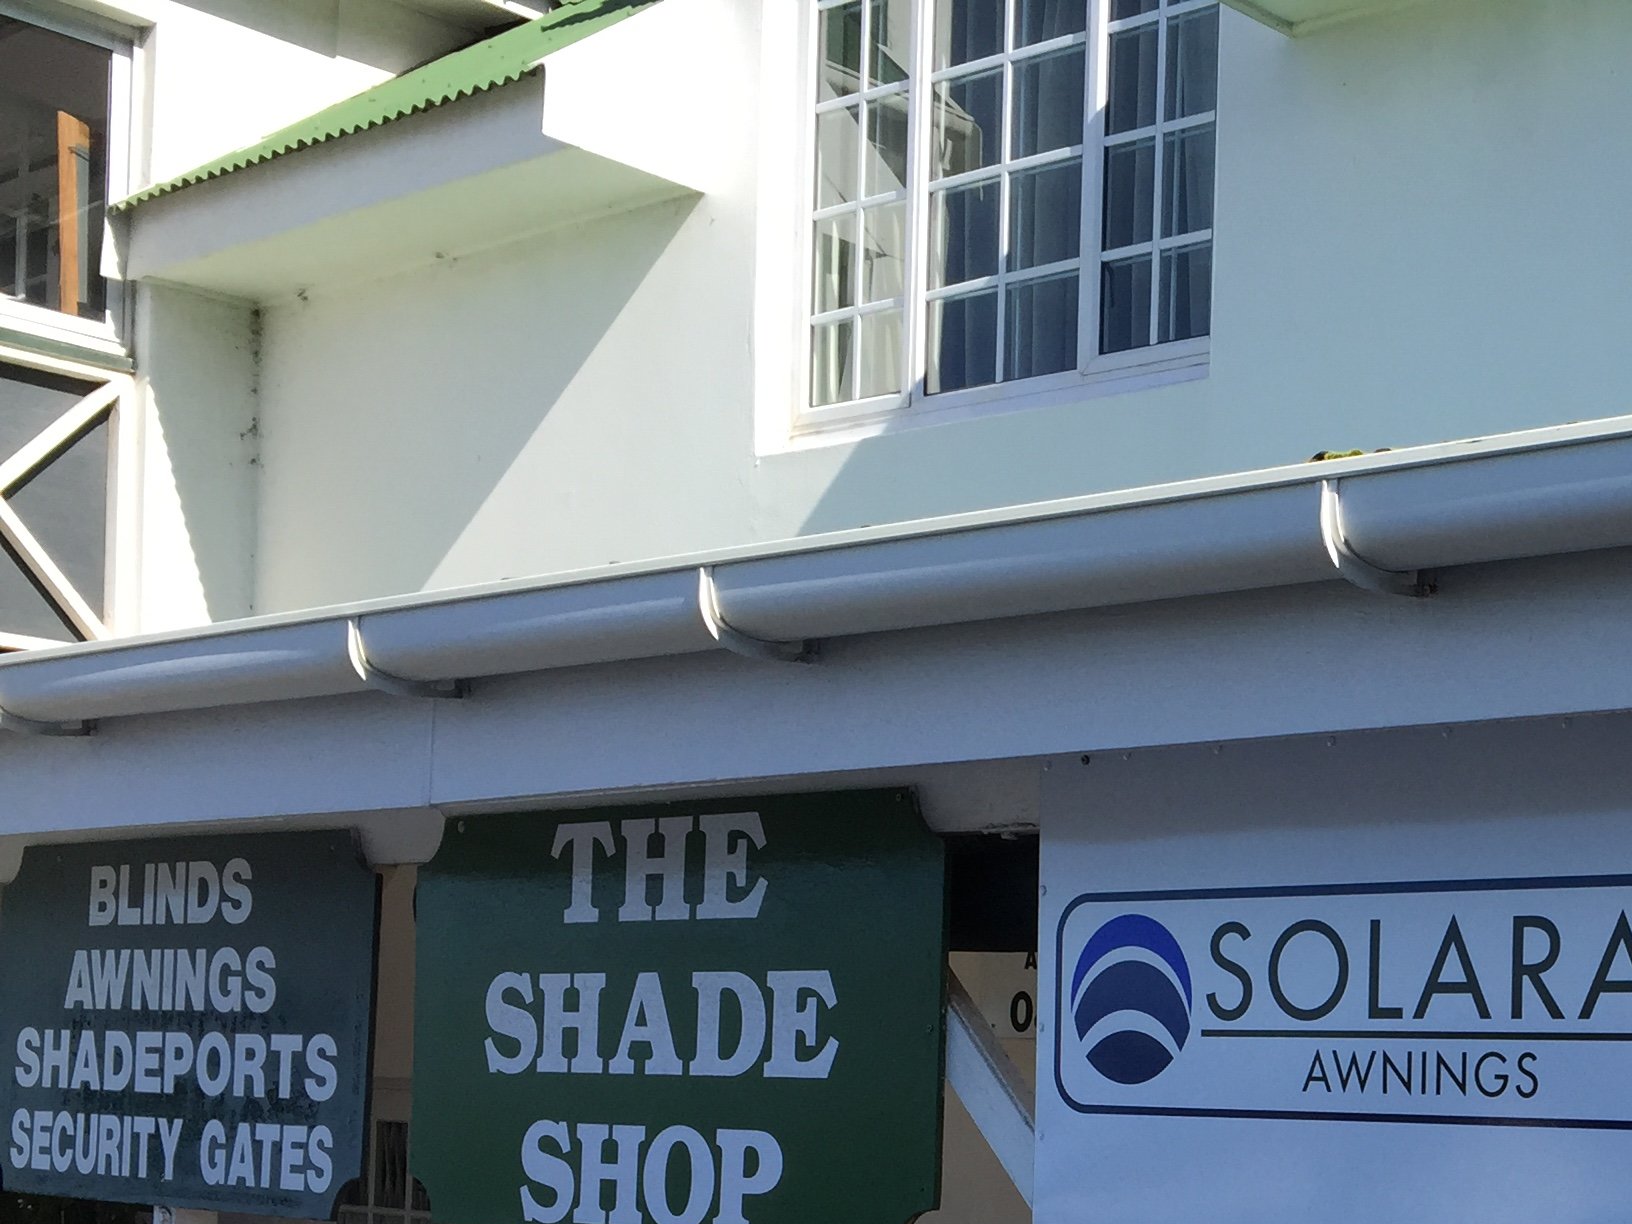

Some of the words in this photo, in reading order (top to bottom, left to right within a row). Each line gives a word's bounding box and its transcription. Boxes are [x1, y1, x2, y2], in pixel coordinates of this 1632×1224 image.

[88, 857, 253, 927] BLINDS
[550, 811, 769, 924] THE
[63, 946, 277, 1014] AWNINGS
[484, 969, 840, 1079] SHADE
[14, 1026, 338, 1102] SHADEPORTS
[1301, 1049, 1540, 1099] AWNINGS
[9, 1107, 184, 1181] SECURITY
[199, 1118, 334, 1194] GATES
